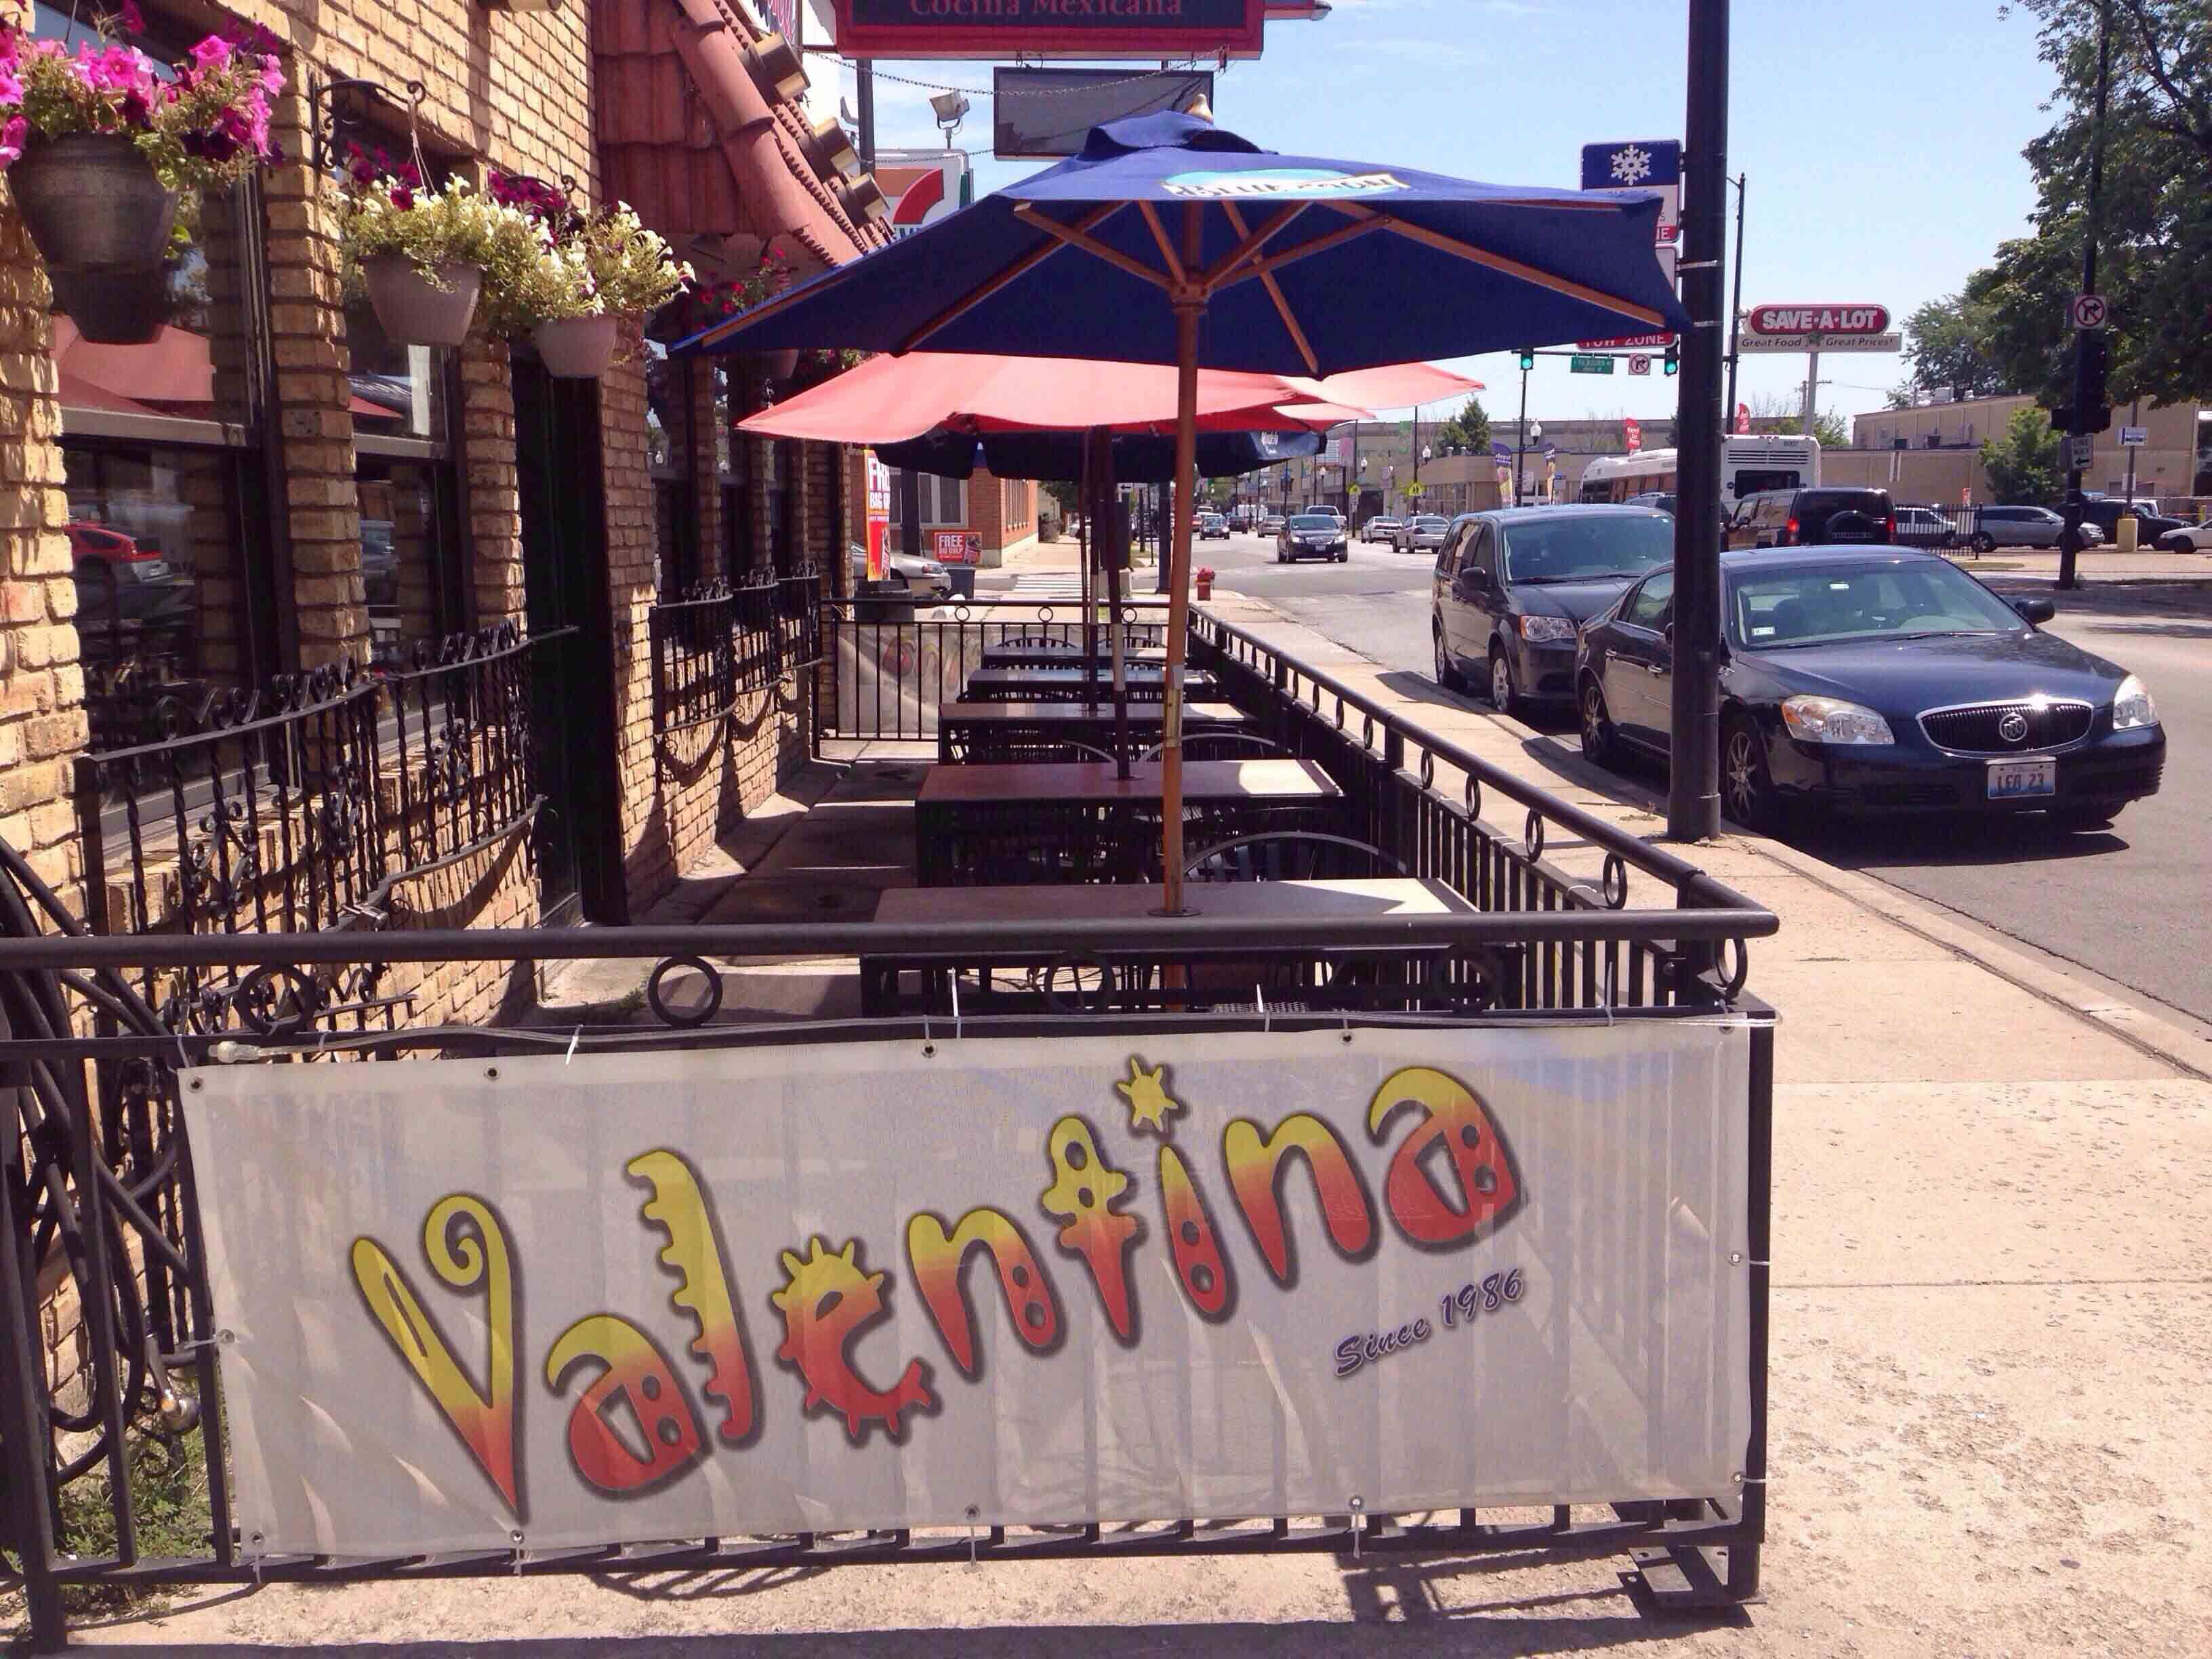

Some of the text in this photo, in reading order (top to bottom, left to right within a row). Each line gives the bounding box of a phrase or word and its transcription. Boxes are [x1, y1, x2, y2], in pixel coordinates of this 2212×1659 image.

[1742, 337, 1893, 347] Great Food Great Prices!
[939, 535, 963, 548] FREE
[352, 1054, 1521, 1515] Valentina
[1334, 1267, 1525, 1376] Since 1986
